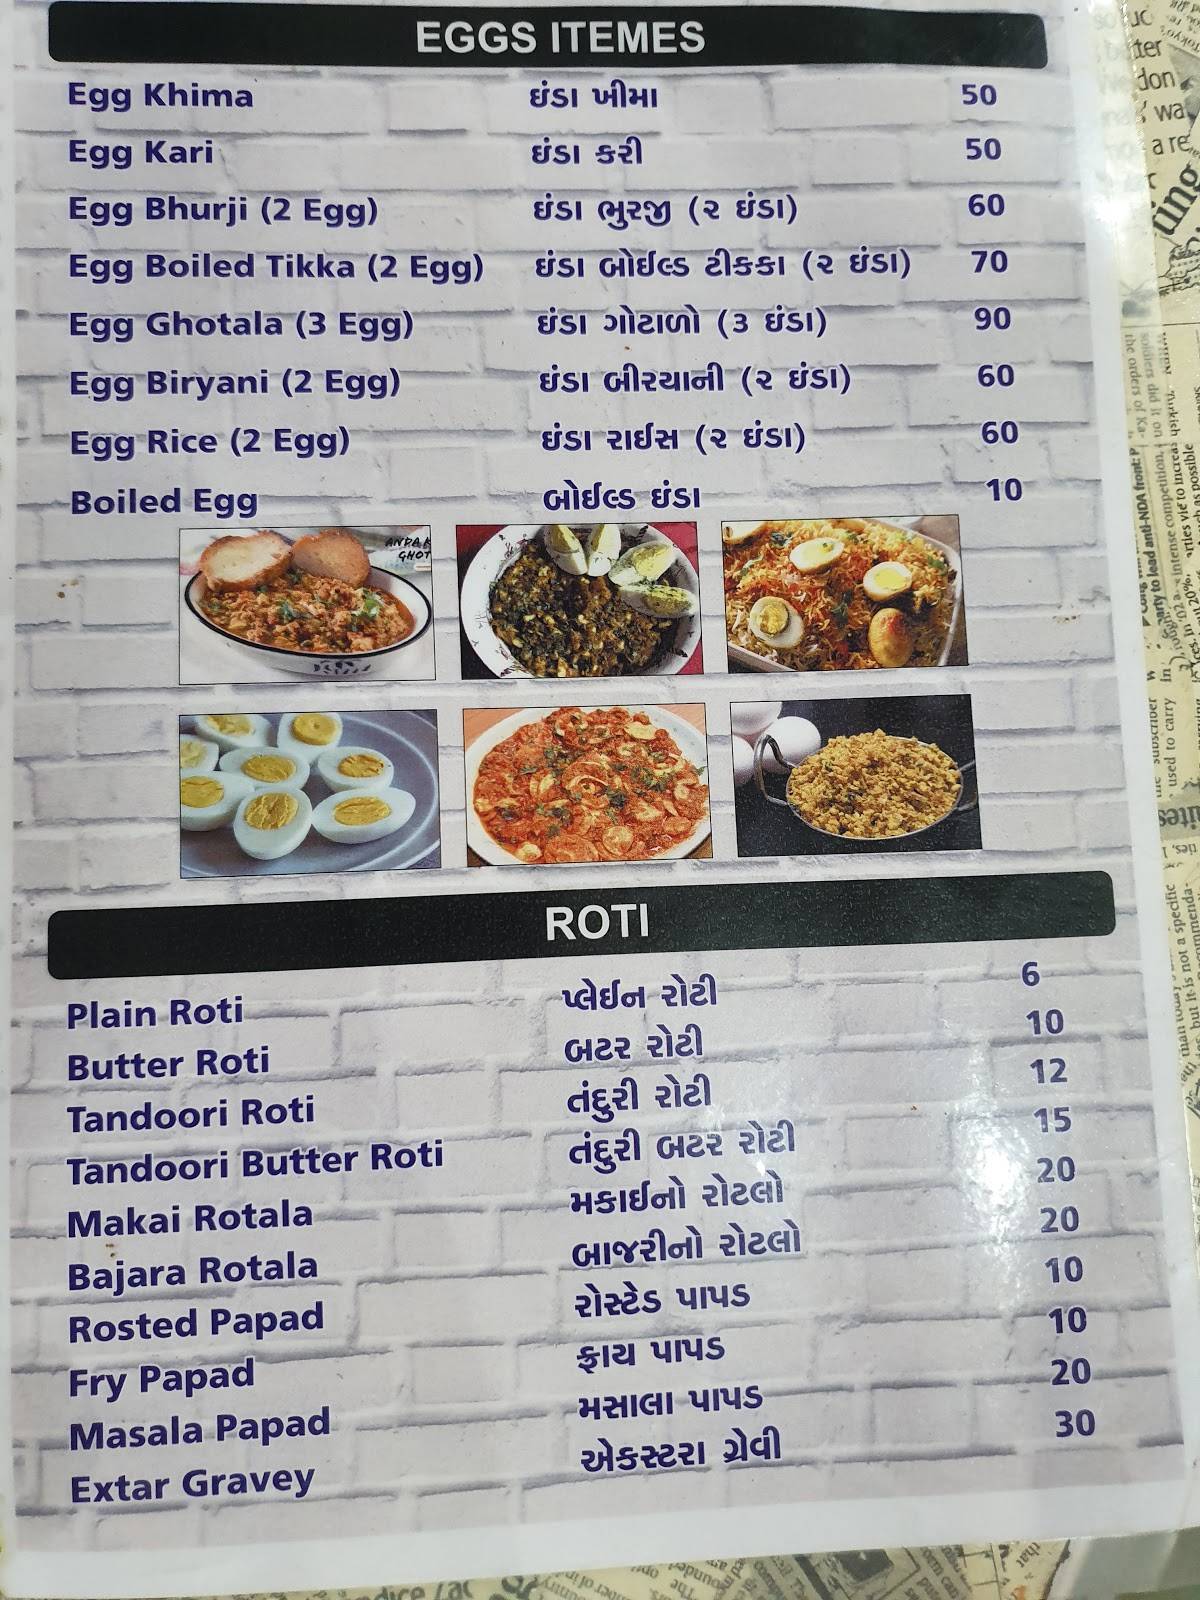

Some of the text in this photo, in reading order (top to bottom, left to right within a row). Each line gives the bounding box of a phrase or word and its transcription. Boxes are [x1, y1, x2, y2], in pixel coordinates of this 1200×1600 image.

[416, 20, 706, 54] EGGS ITEMES
[68, 81, 253, 113] Egg Khima
[529, 78, 658, 109] ઇંડા ખીમા
[961, 84, 997, 106] 50
[68, 139, 213, 170] Egg Kari
[531, 135, 643, 165] ઇંડા કરી
[966, 138, 1002, 161] 50
[69, 195, 378, 228] Egg Bhurji (2 Egg)
[533, 192, 582, 221] ઇંડા
[597, 200, 671, 231] ભુરજી
[968, 193, 1005, 217] 60
[69, 252, 484, 286] Egg Boiled Tikka (2 Egg)
[535, 249, 585, 278] ઇંડા
[598, 247, 690, 278] બોઈલ્ડ
[704, 247, 785, 277] ટીકકા
[971, 250, 1008, 273] 70
[69, 310, 413, 343] Egg Ghotala (3 Egg)
[537, 306, 587, 336] ઇંડા
[603, 304, 700, 335] ગોટાળો
[974, 306, 1011, 331] 90
[70, 367, 400, 402] Egg Biryani (2 Egg)
[539, 364, 589, 393] ઇંડા
[603, 361, 724, 393] બીરયાની
[977, 364, 1015, 387] 60
[71, 425, 350, 462] Egg Rice (2 Egg)
[541, 422, 592, 452] ઇંડા
[606, 422, 679, 451] રાઈસ
[981, 420, 1019, 445] 60
[71, 487, 258, 519] Boiled Egg
[543, 479, 700, 511] બોઈલ્ડ ઇંડા
[986, 478, 1023, 502] 10
[545, 903, 649, 941] ROTI
[1021, 961, 1041, 987] 6
[561, 973, 717, 1011] પ્લેઈન રોટી
[67, 995, 243, 1030] Plain Roti
[1025, 1008, 1064, 1035] 10
[564, 1023, 703, 1063] બટર રોટી
[68, 1045, 269, 1081] Butter Roti
[1029, 1057, 1069, 1084] 12
[66, 1094, 314, 1133] Tandoori Roti
[567, 1073, 711, 1124] તંદુરી રોટી
[1033, 1106, 1072, 1133] 15
[66, 1139, 443, 1186] Tandoori Butter Roti
[568, 1119, 796, 1175] તંદુરી બટર રોટી
[1036, 1156, 1076, 1183] 20
[570, 1168, 785, 1215] મકાઈનો રોટલો
[68, 1199, 313, 1239] Makai Rotala
[1039, 1205, 1080, 1233] 20
[572, 1218, 802, 1268] બાજરીનો રોટલો
[68, 1250, 318, 1297] Bajara Rotala
[1044, 1255, 1084, 1284] 10
[574, 1280, 751, 1318] રોસ્ટેડ પાપડ
[69, 1300, 324, 1344] Rosted Papad
[1048, 1306, 1087, 1334] 10
[576, 1336, 725, 1374] ફ્રાય પાપડ
[69, 1358, 254, 1403] Fry Papad
[1050, 1357, 1092, 1386] 20
[578, 1385, 763, 1420] મસાલા પાપડ
[70, 1407, 330, 1451] Masala Papad
[1054, 1408, 1096, 1438] 30
[71, 1469, 314, 1504] Extar Gravey
